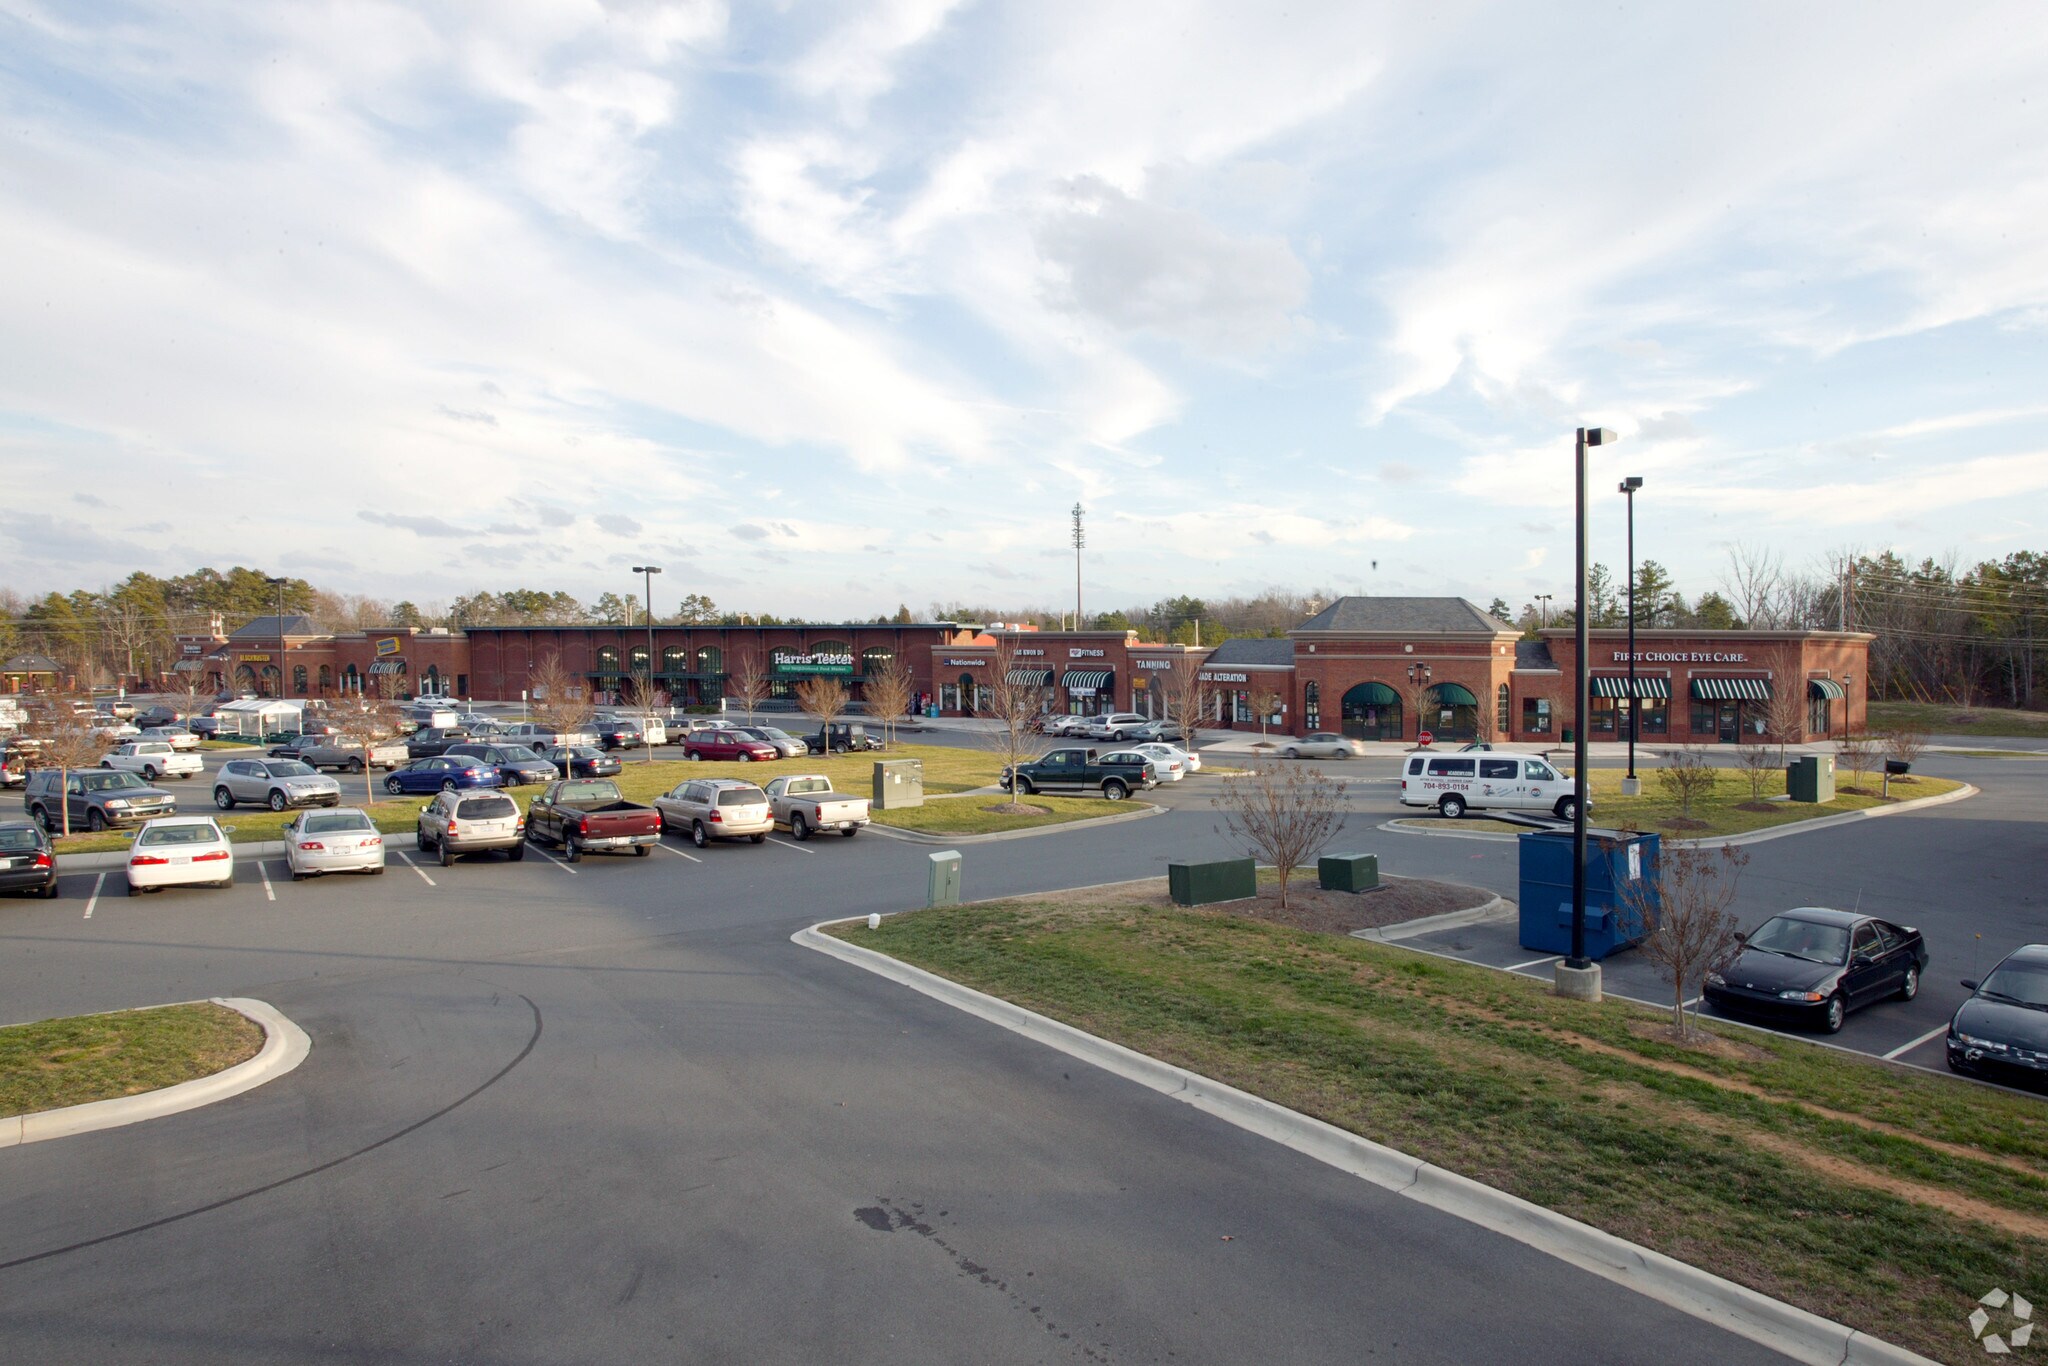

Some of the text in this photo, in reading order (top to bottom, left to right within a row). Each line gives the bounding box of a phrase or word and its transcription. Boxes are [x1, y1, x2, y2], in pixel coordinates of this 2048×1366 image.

[1081, 649, 1104, 657] FITNESS
[1646, 651, 1688, 661] CHOICE
[1690, 652, 1711, 661] EYE
[1714, 652, 1744, 662] CARE
[240, 654, 270, 662] BLOCKBUSTER
[774, 652, 853, 664] Harris Teeter
[1136, 660, 1171, 669] TANNING
[1199, 672, 1247, 682] JADE ALTERATION
[1423, 782, 1469, 791] 704-893-0184
